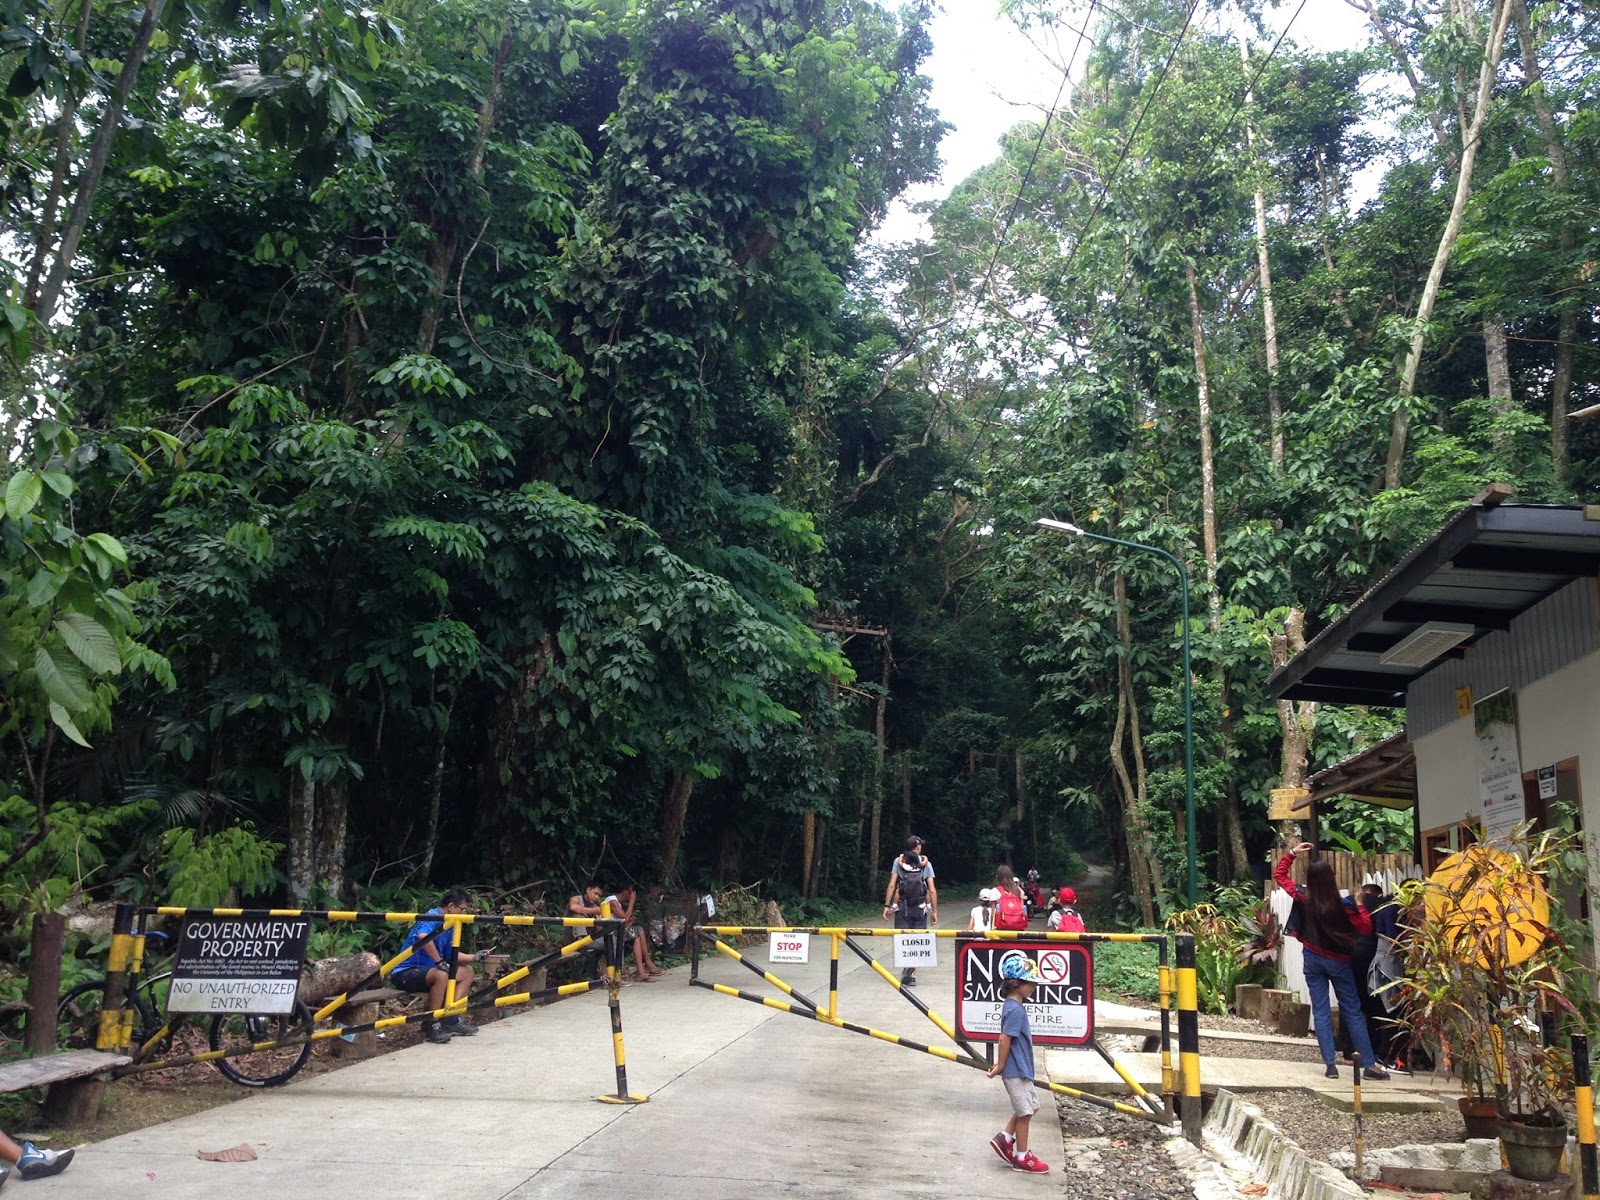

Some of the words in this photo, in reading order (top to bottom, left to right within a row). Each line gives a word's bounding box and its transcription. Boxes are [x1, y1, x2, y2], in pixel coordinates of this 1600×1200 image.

[186, 922, 307, 939] GOVERNMENT
[776, 942, 802, 951] STOP
[902, 938, 930, 946] CLOSED
[200, 941, 284, 957] PROPERTY
[173, 983, 193, 994] NO
[200, 983, 295, 995] UNAUTHORIZED
[211, 997, 251, 1009] ENTRY
[1035, 1015, 1062, 1024] FIRE
